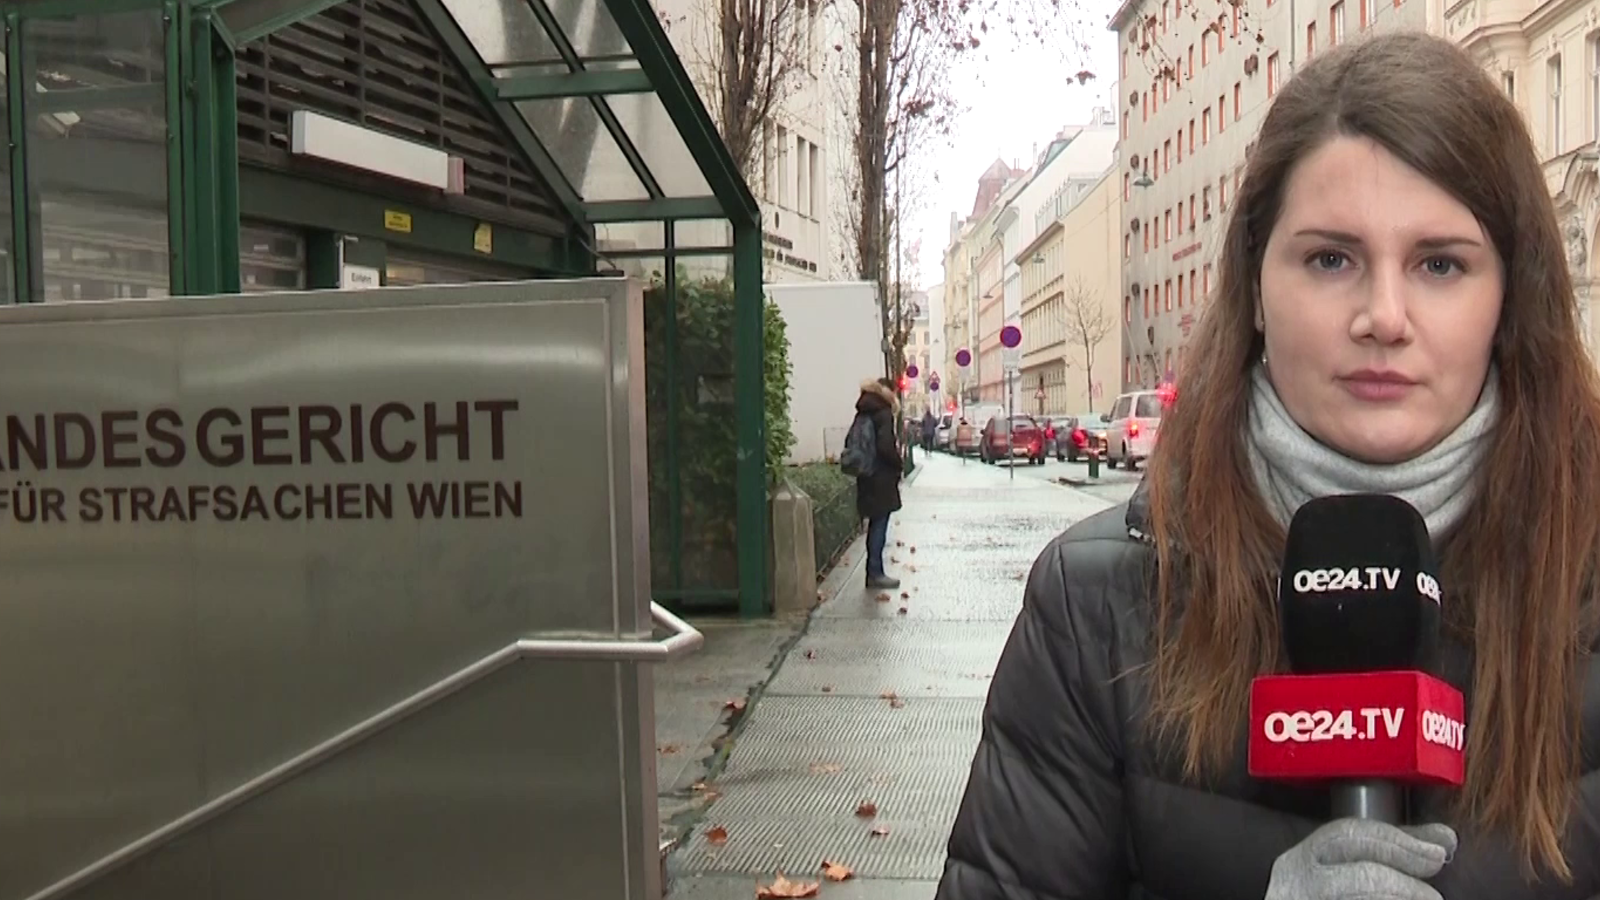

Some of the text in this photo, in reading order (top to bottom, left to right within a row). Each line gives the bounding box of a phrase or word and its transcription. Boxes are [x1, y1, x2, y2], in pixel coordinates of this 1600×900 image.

[0, 400, 519, 471] NDESGERICHT
[79, 482, 392, 523] STRAFSACHEN
[408, 481, 523, 518] WIEN
[1293, 567, 1400, 593] oe24.TV
[1264, 707, 1404, 742] oe24.TV
